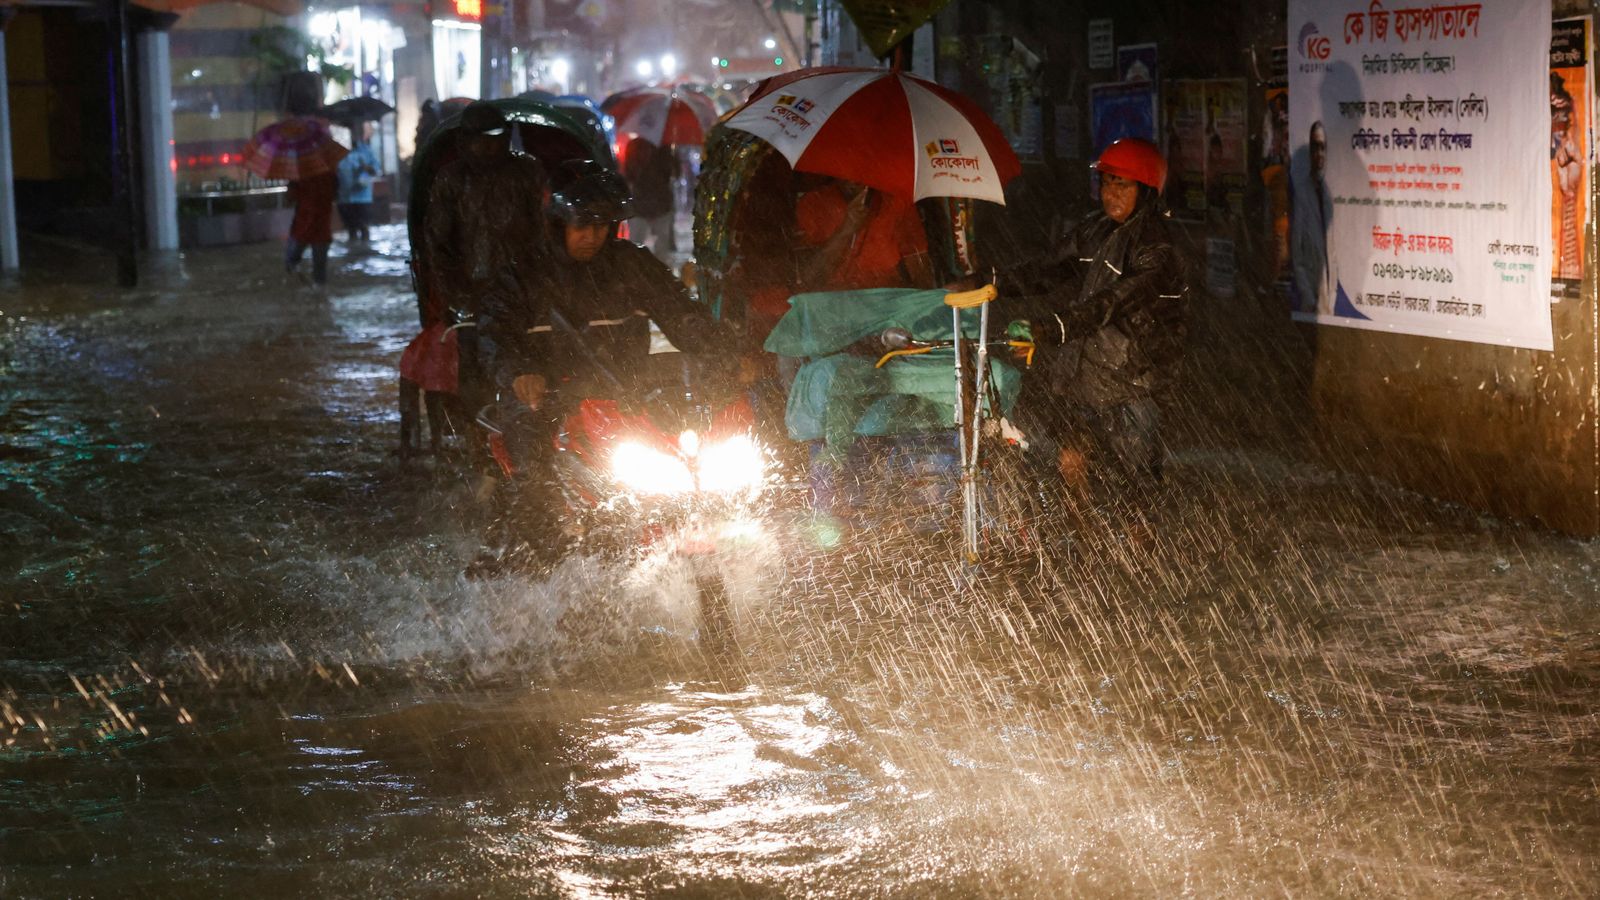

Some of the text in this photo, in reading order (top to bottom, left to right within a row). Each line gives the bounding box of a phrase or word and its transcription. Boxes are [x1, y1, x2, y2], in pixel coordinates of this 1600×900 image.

[1344, 0, 1482, 45] কে জি হাসপাতালে
[1307, 37, 1330, 60] KG
[771, 105, 811, 131] কোকোলা
[931, 156, 979, 170] কোকোলা
